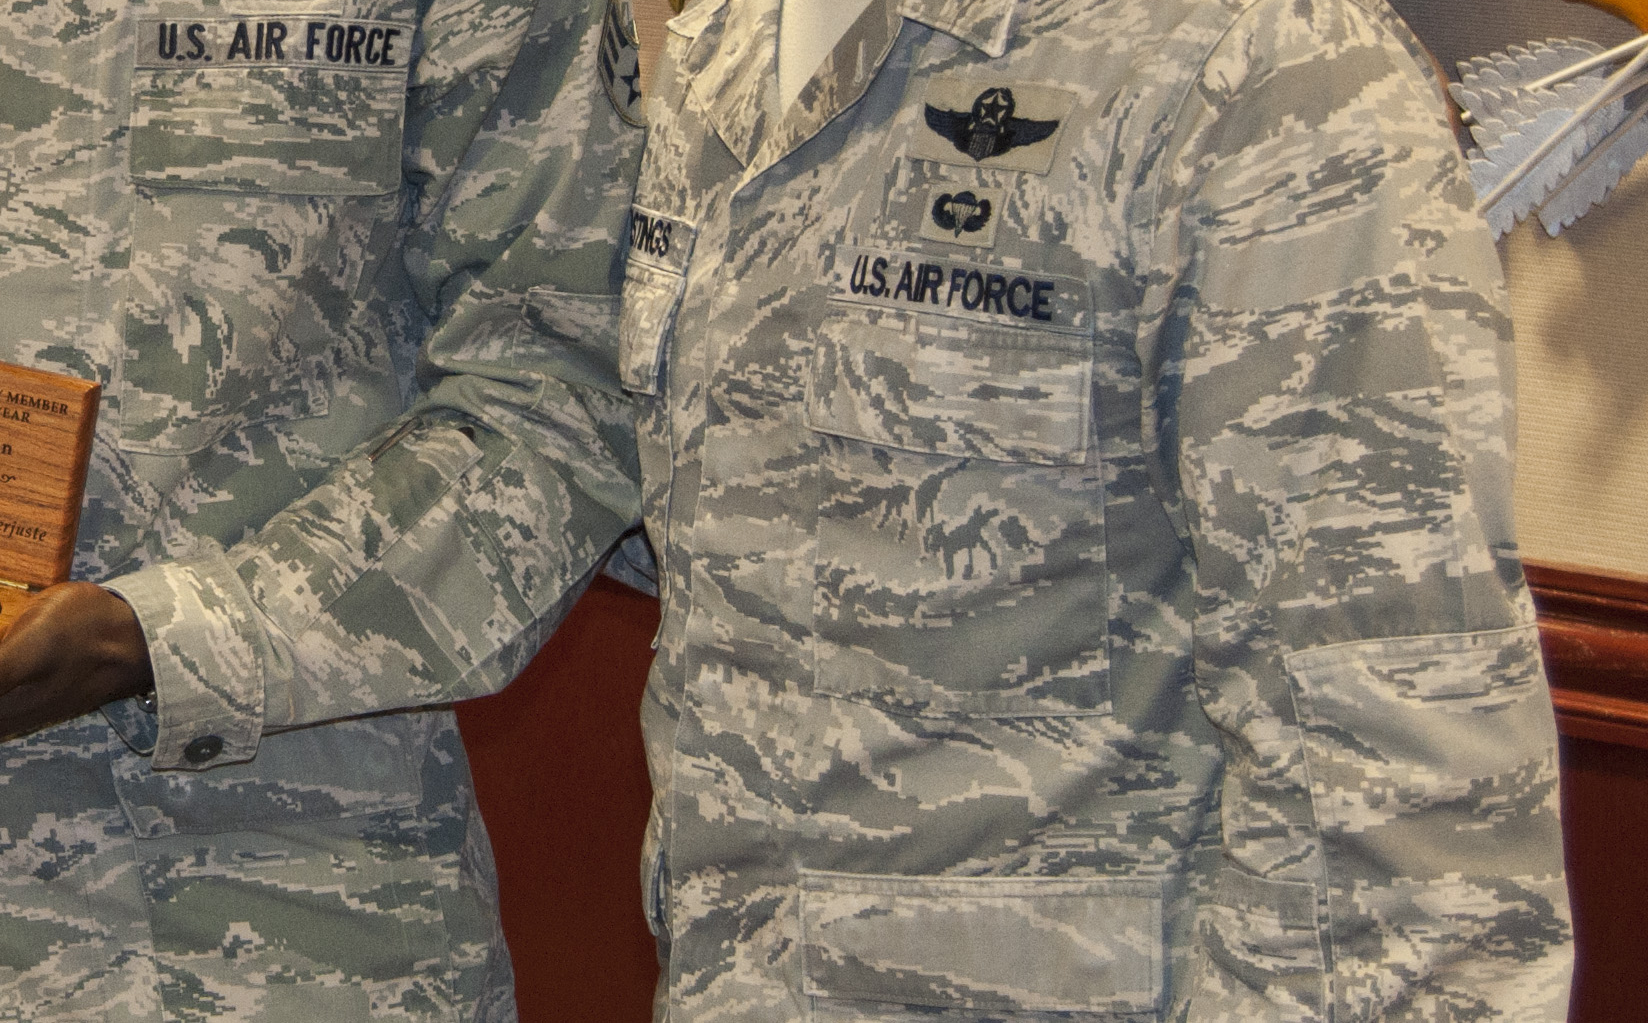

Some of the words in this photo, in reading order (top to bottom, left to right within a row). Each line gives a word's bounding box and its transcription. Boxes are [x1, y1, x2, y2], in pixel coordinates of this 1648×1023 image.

[158, 22, 213, 62] U.S.
[227, 21, 288, 60] AIR
[305, 21, 401, 66] FORCE
[850, 254, 890, 298] U.S.
[893, 260, 944, 305] AIR
[946, 267, 1055, 321] FORCE
[6, 391, 69, 415] MEMBER
